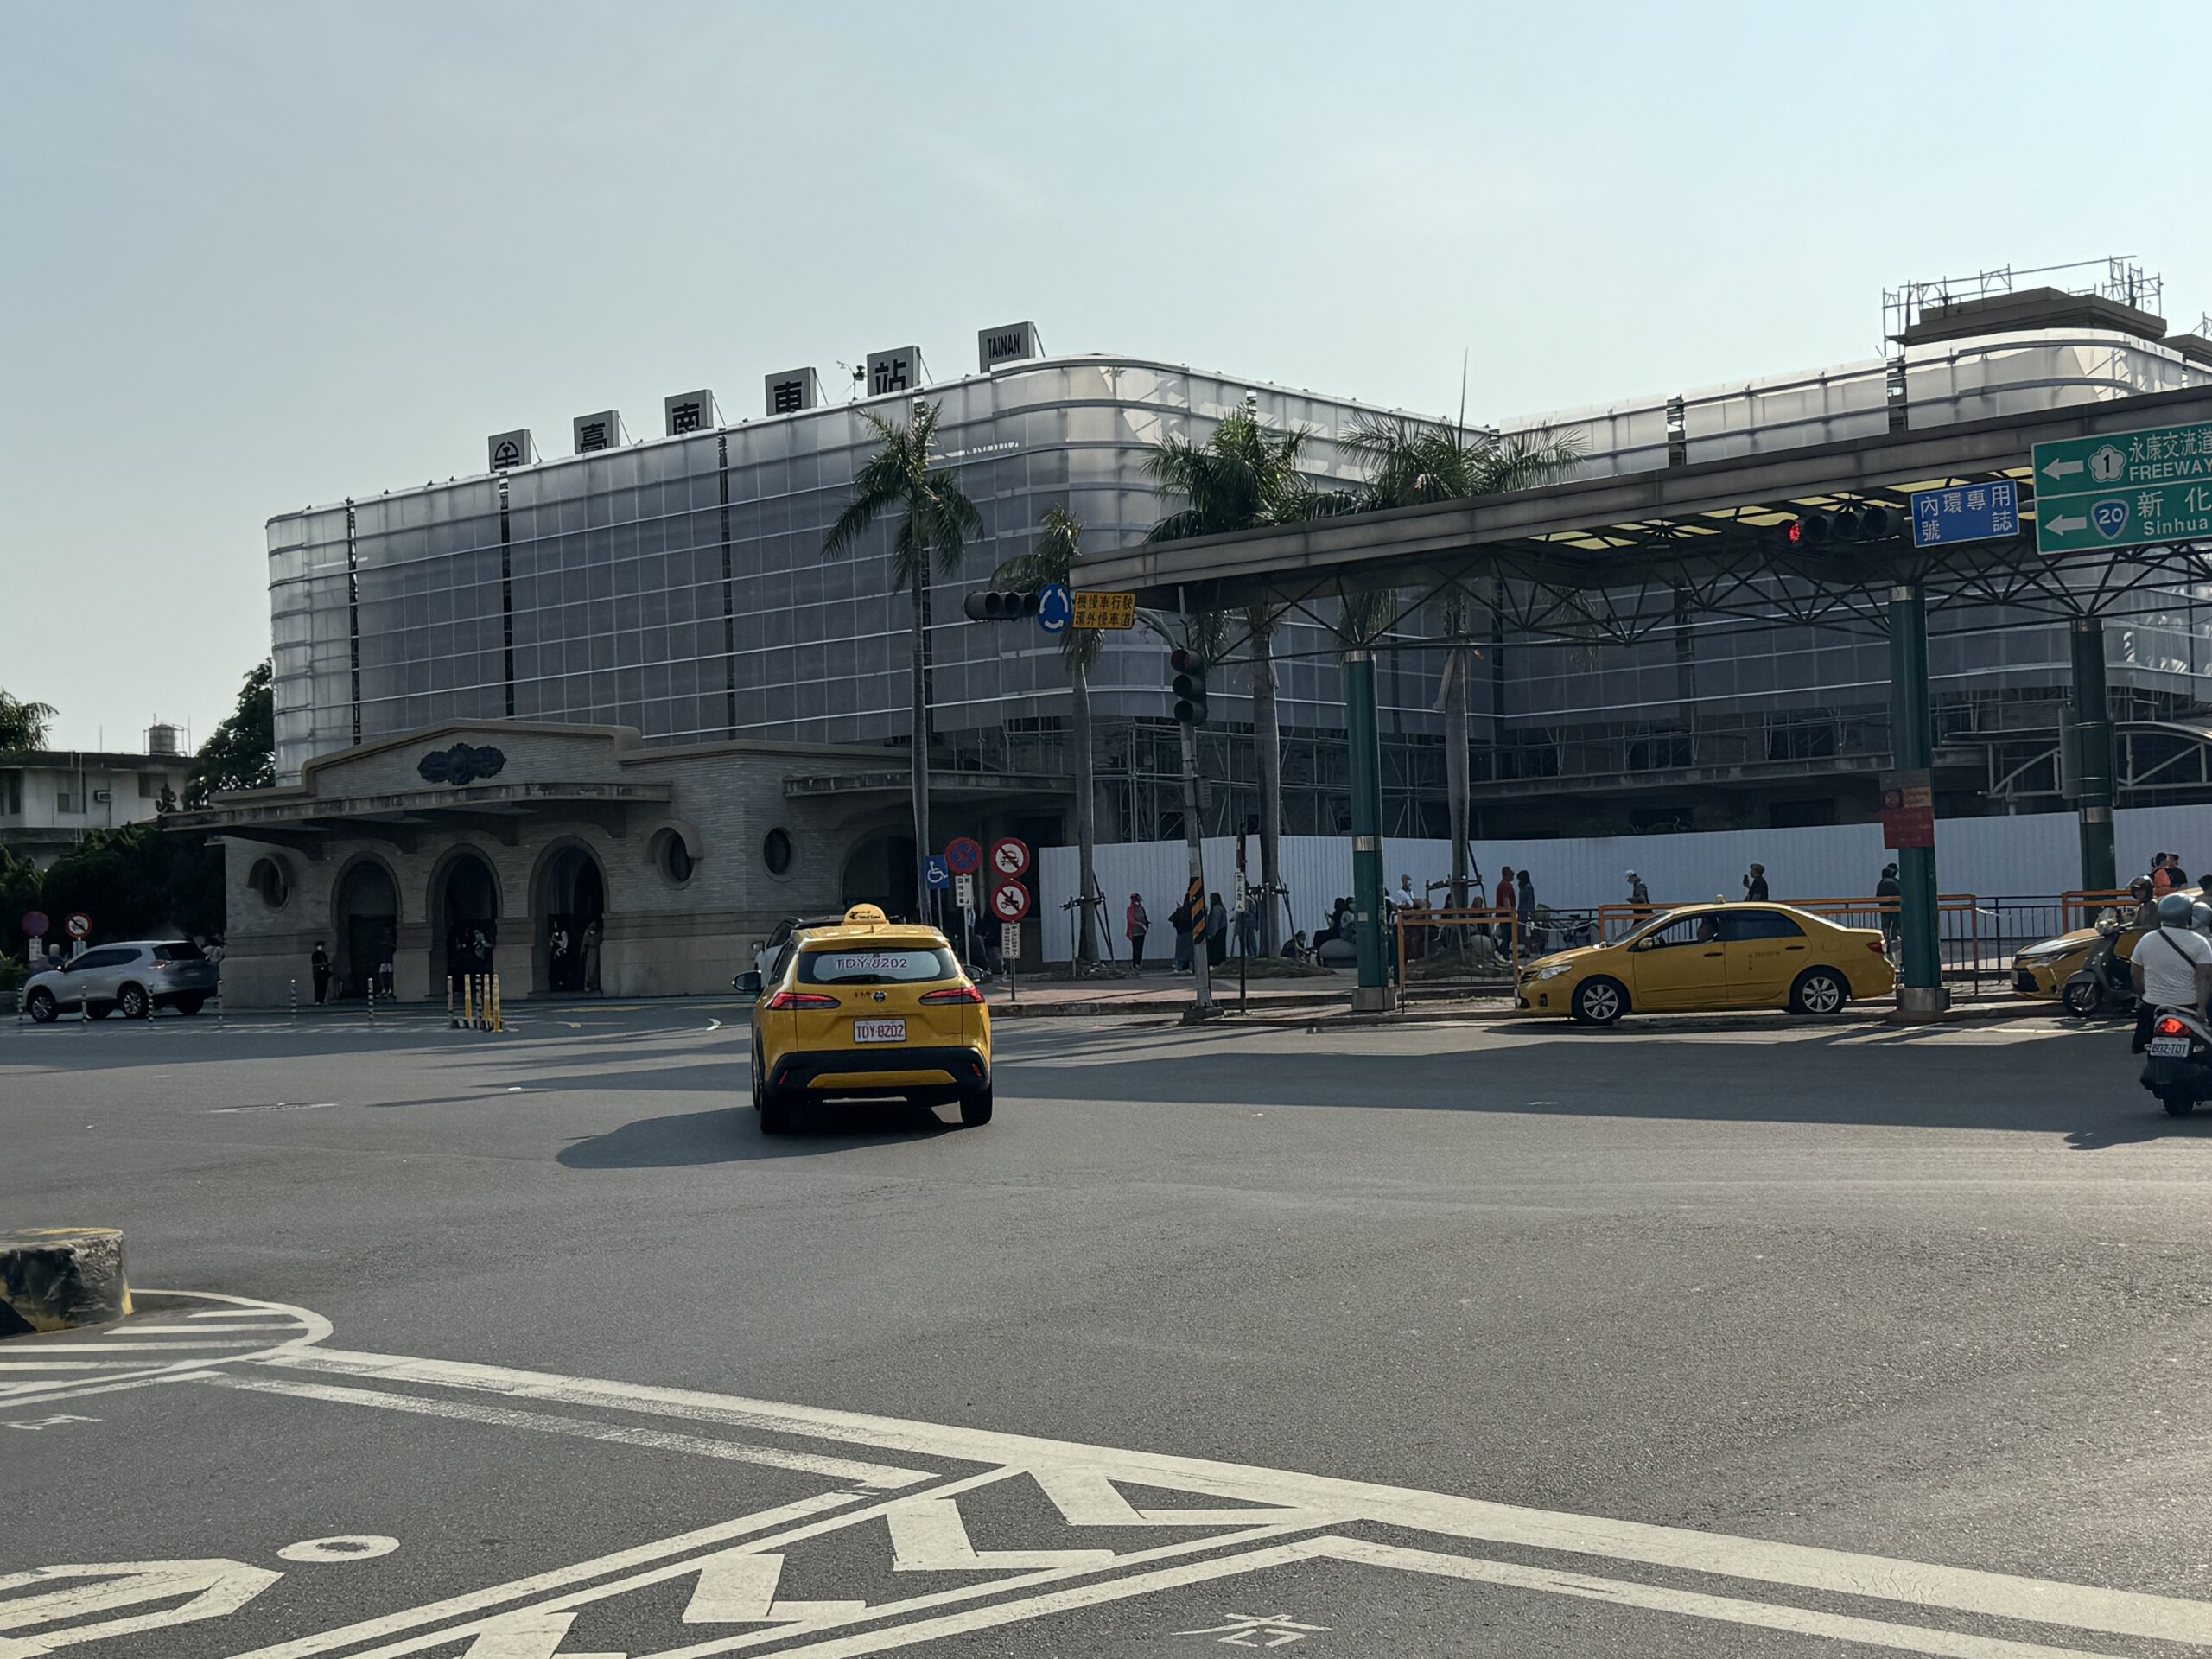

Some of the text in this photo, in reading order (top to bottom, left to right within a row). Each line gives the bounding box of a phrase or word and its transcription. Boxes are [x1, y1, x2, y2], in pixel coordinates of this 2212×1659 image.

[987, 332, 1020, 359] TAINAN
[2129, 428, 2212, 462] 永康交流道
[2103, 454, 2110, 474] 1
[2129, 458, 2212, 481] FREEWAY
[1920, 485, 2011, 518] 內環專用
[2098, 507, 2124, 524] 20
[2144, 518, 2209, 536] Sinhua
